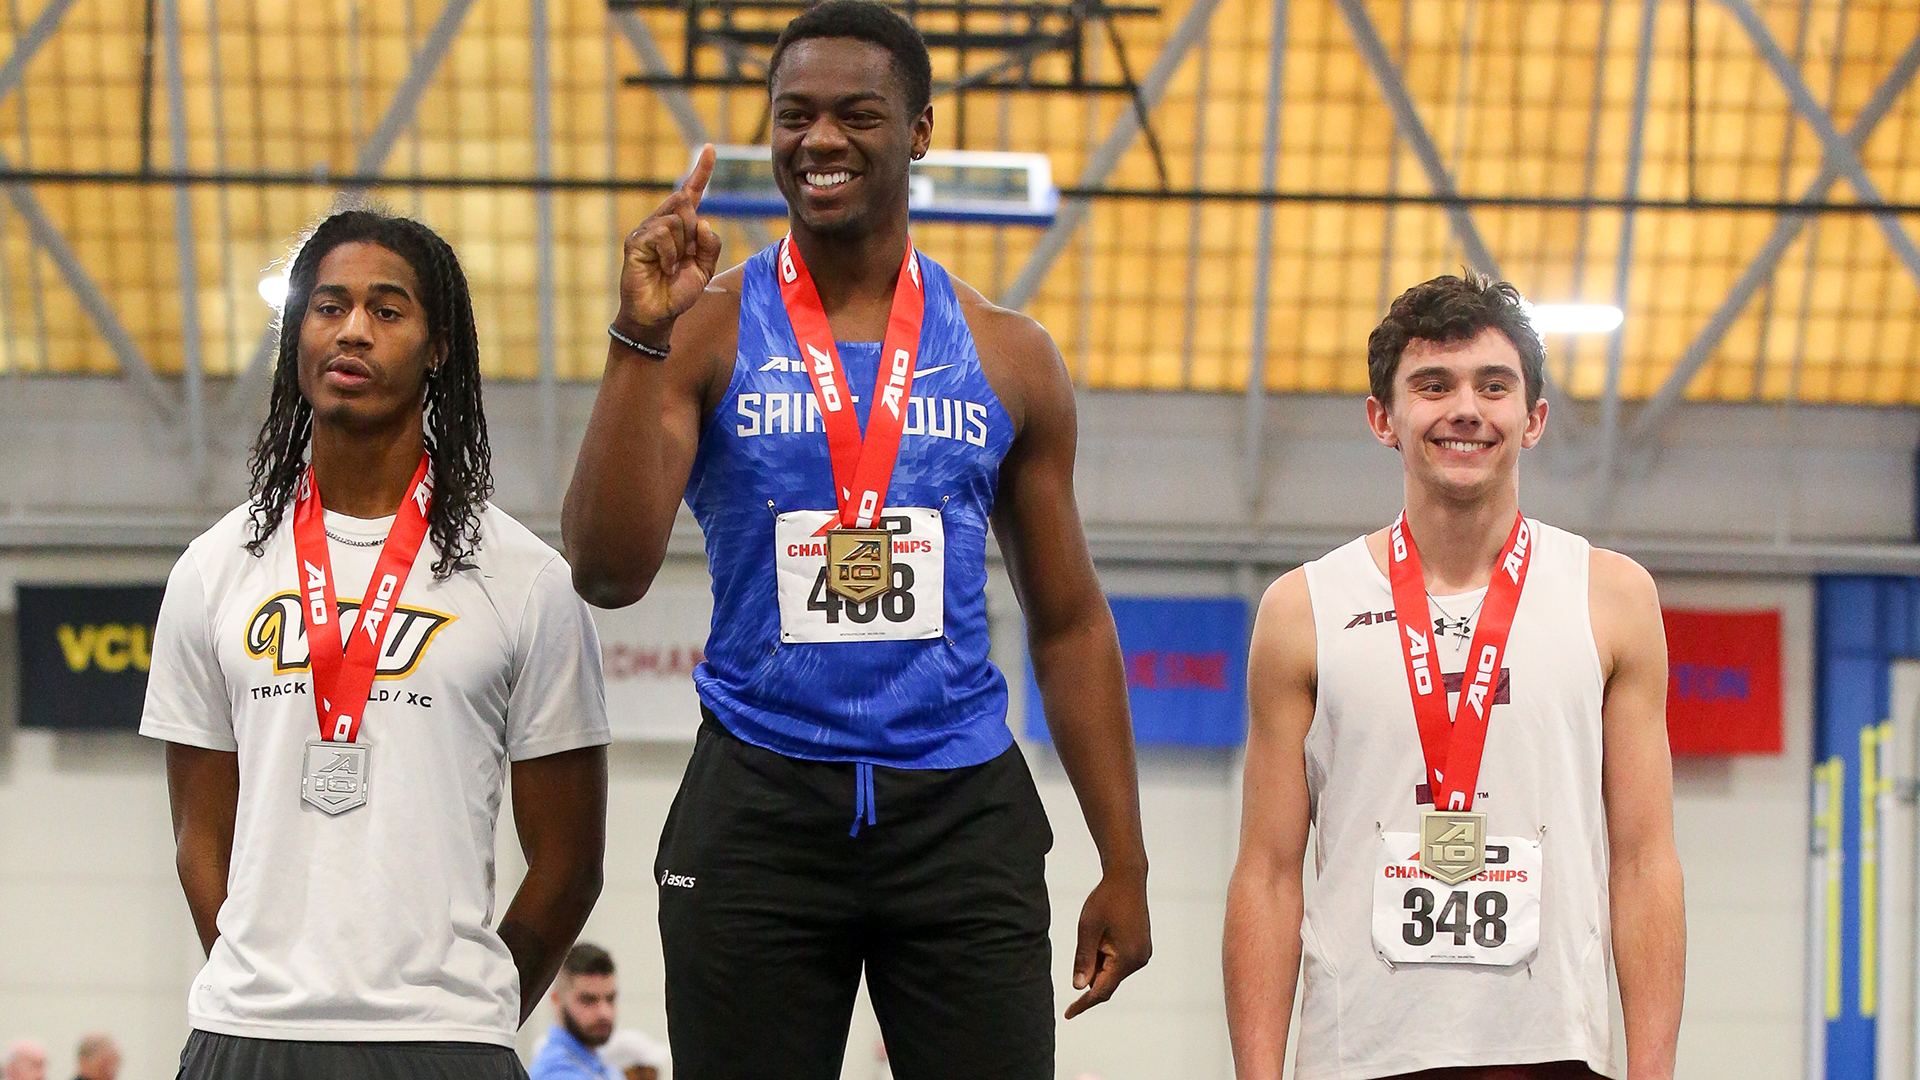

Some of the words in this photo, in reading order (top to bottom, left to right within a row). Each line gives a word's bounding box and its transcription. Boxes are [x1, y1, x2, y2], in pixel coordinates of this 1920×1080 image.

[806, 343, 842, 412] A10
[881, 348, 910, 421] A10
[737, 393, 859, 437] SAIN
[902, 396, 987, 448] OUIS
[834, 563, 881, 581] 10
[1501, 521, 1530, 585] A10
[305, 559, 332, 625] A10
[360, 574, 398, 646] A10
[244, 590, 460, 680] VU
[1405, 624, 1433, 696] A10
[251, 682, 307, 700] TRACK
[406, 692, 433, 708] XC
[1465, 644, 1497, 721] A10
[1429, 845, 1475, 862] 10
[1435, 821, 1475, 843] A
[667, 874, 696, 888] asics
[1402, 887, 1508, 948] 348
